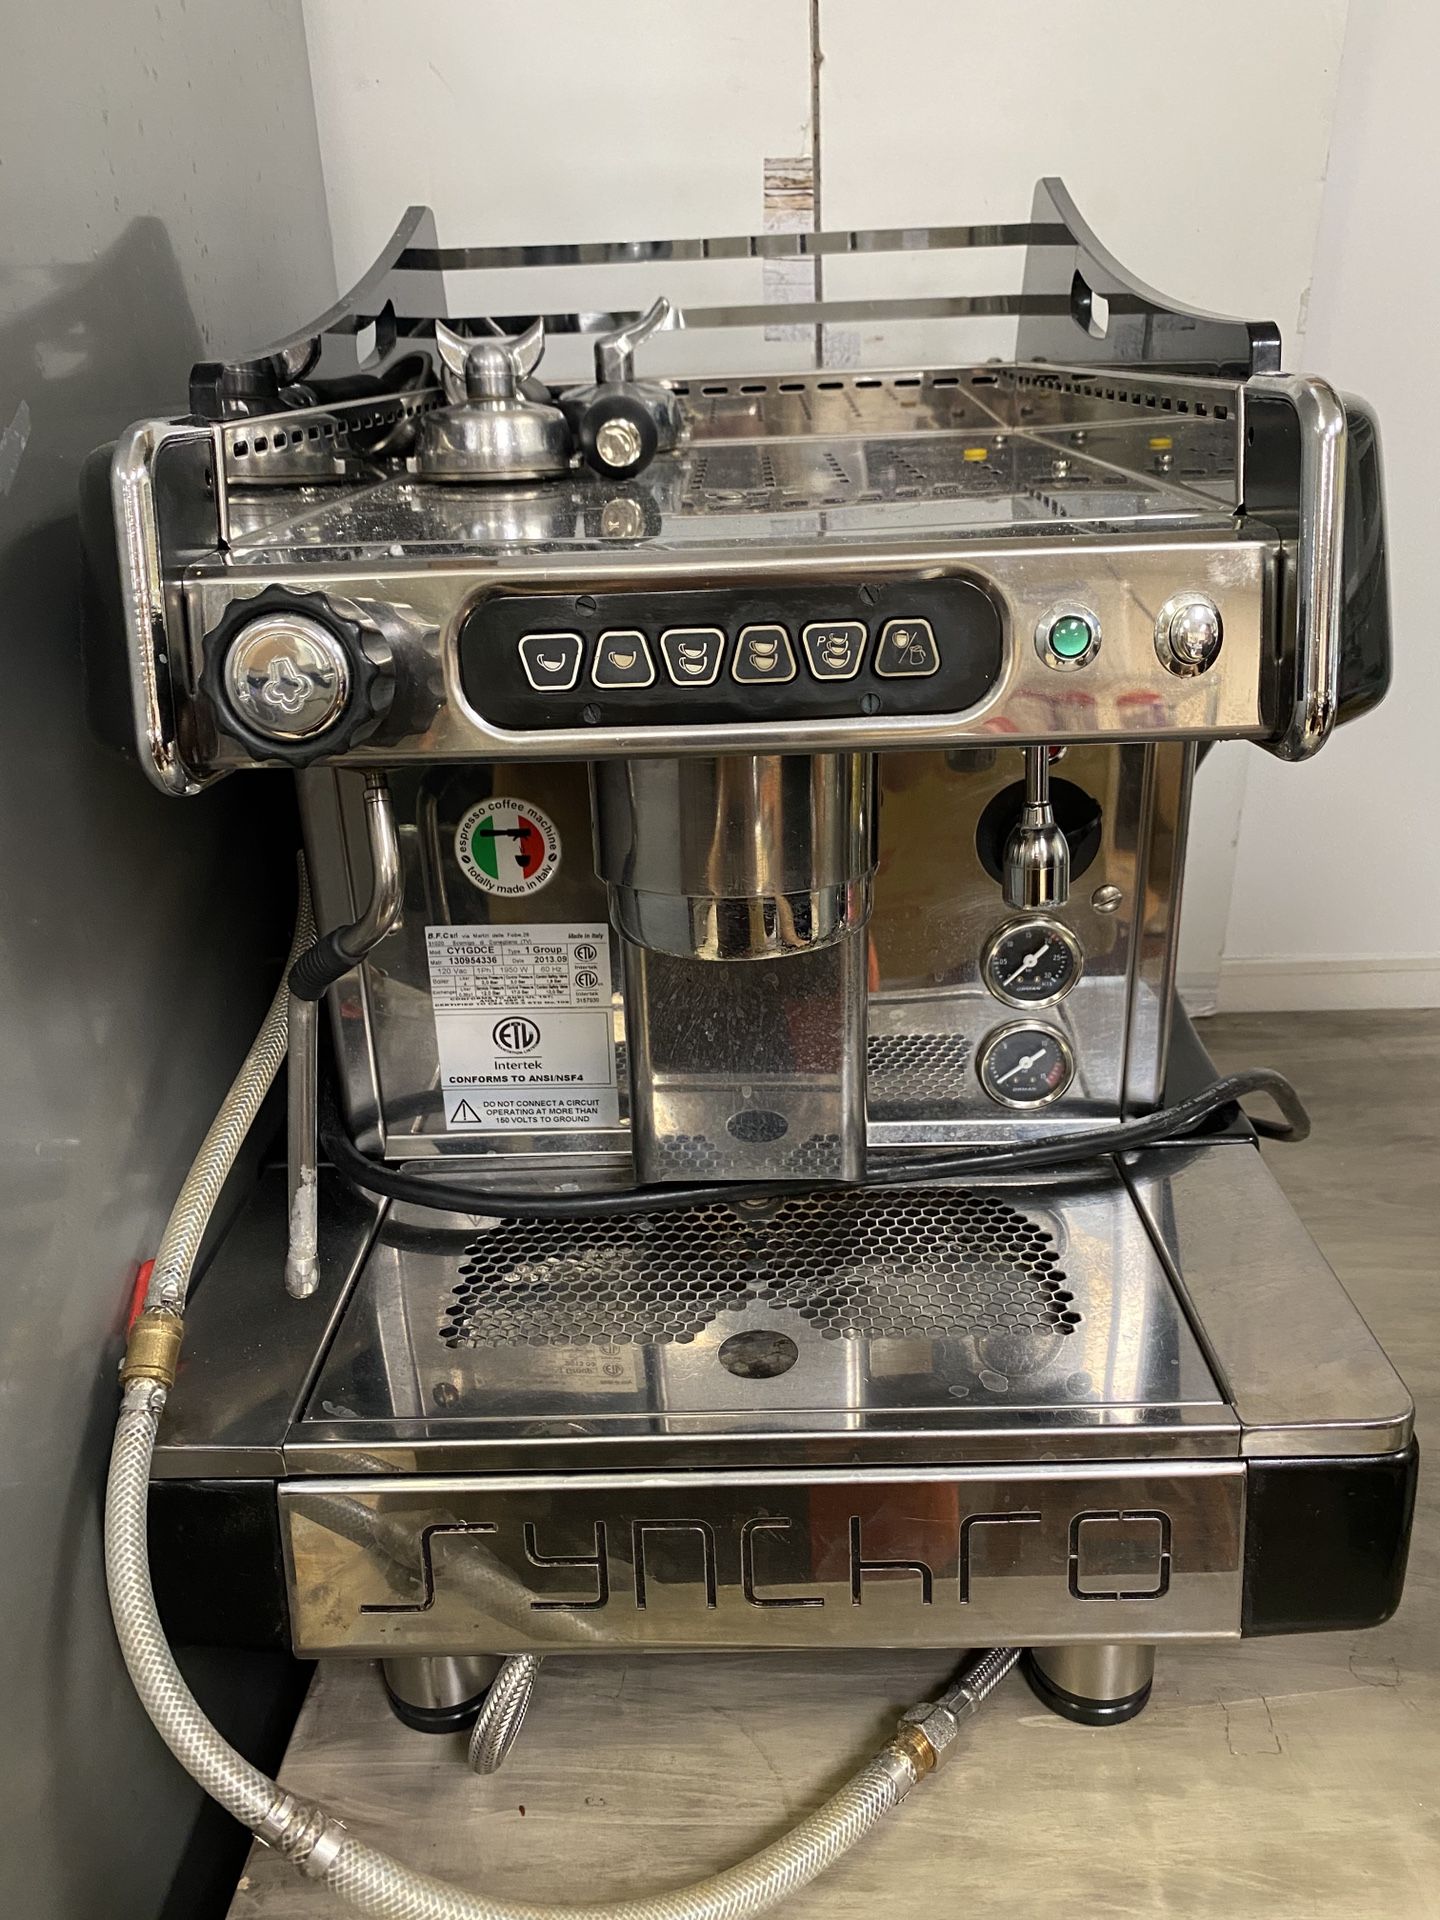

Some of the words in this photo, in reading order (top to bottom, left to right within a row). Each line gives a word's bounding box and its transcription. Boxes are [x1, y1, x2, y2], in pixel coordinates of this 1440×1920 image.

[459, 807, 486, 853] espresso
[488, 799, 525, 812] coffee
[527, 808, 557, 851] machine
[467, 866, 495, 891] totally
[496, 884, 525, 894] made
[527, 881, 537, 890] in
[535, 864, 555, 883] Italy
[446, 946, 495, 955] CY1GDCE
[532, 946, 562, 955] Group
[448, 956, 497, 965] 130954336
[534, 955, 568, 964] 2013.09
[499, 1021, 534, 1050] ETL
[494, 1060, 543, 1070] Intertek
[449, 1075, 509, 1084] CONFORMS
[511, 1075, 526, 1083] TO
[497, 1100, 514, 1108] NOT
[567, 1099, 600, 1107] CIRCUIT
[486, 1108, 535, 1116] OPERATING
[496, 1116, 510, 1124] 150
[553, 1115, 590, 1123] GROUND
